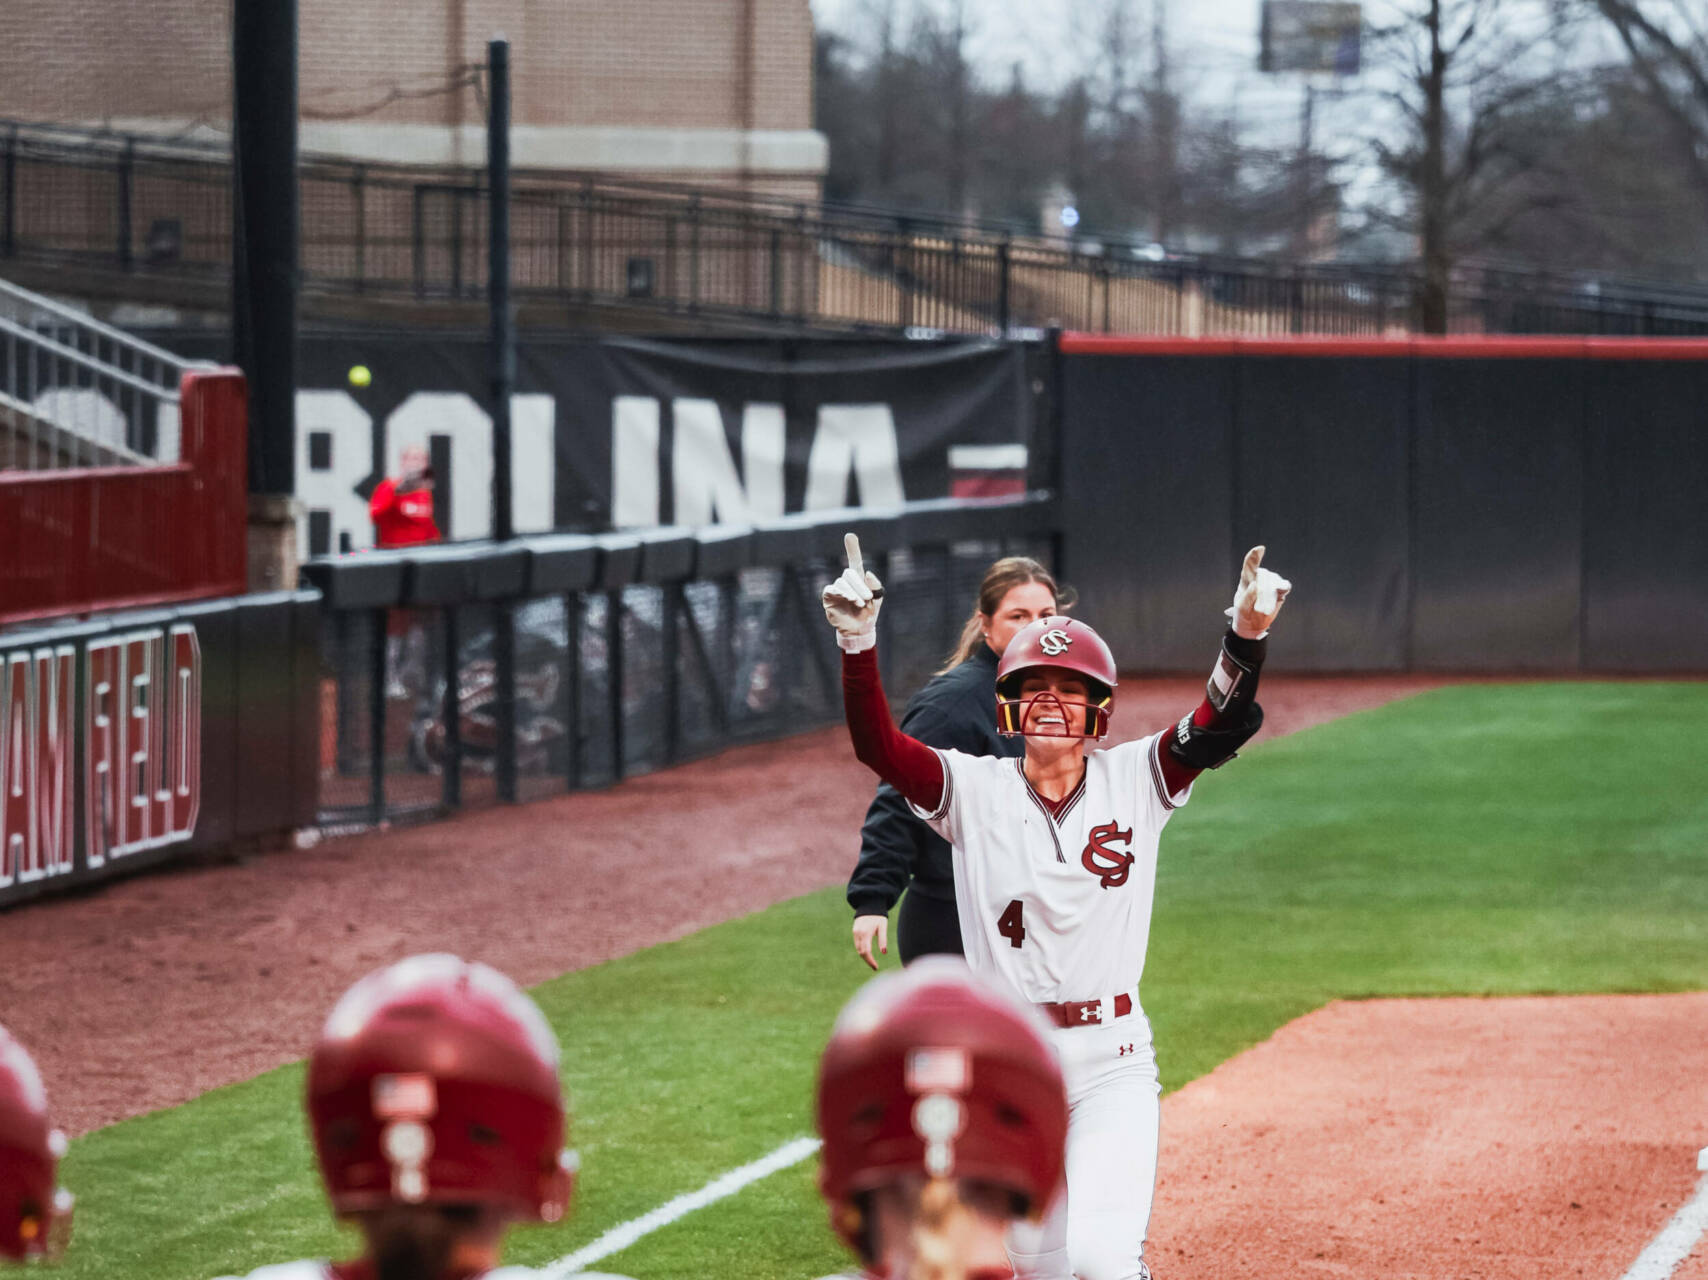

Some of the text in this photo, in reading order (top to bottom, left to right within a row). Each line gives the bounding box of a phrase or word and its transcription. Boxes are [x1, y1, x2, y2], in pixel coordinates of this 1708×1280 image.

[32, 386, 905, 558] ROLINA
[0, 622, 201, 888] AM FIELD
[997, 899, 1026, 949] 4
